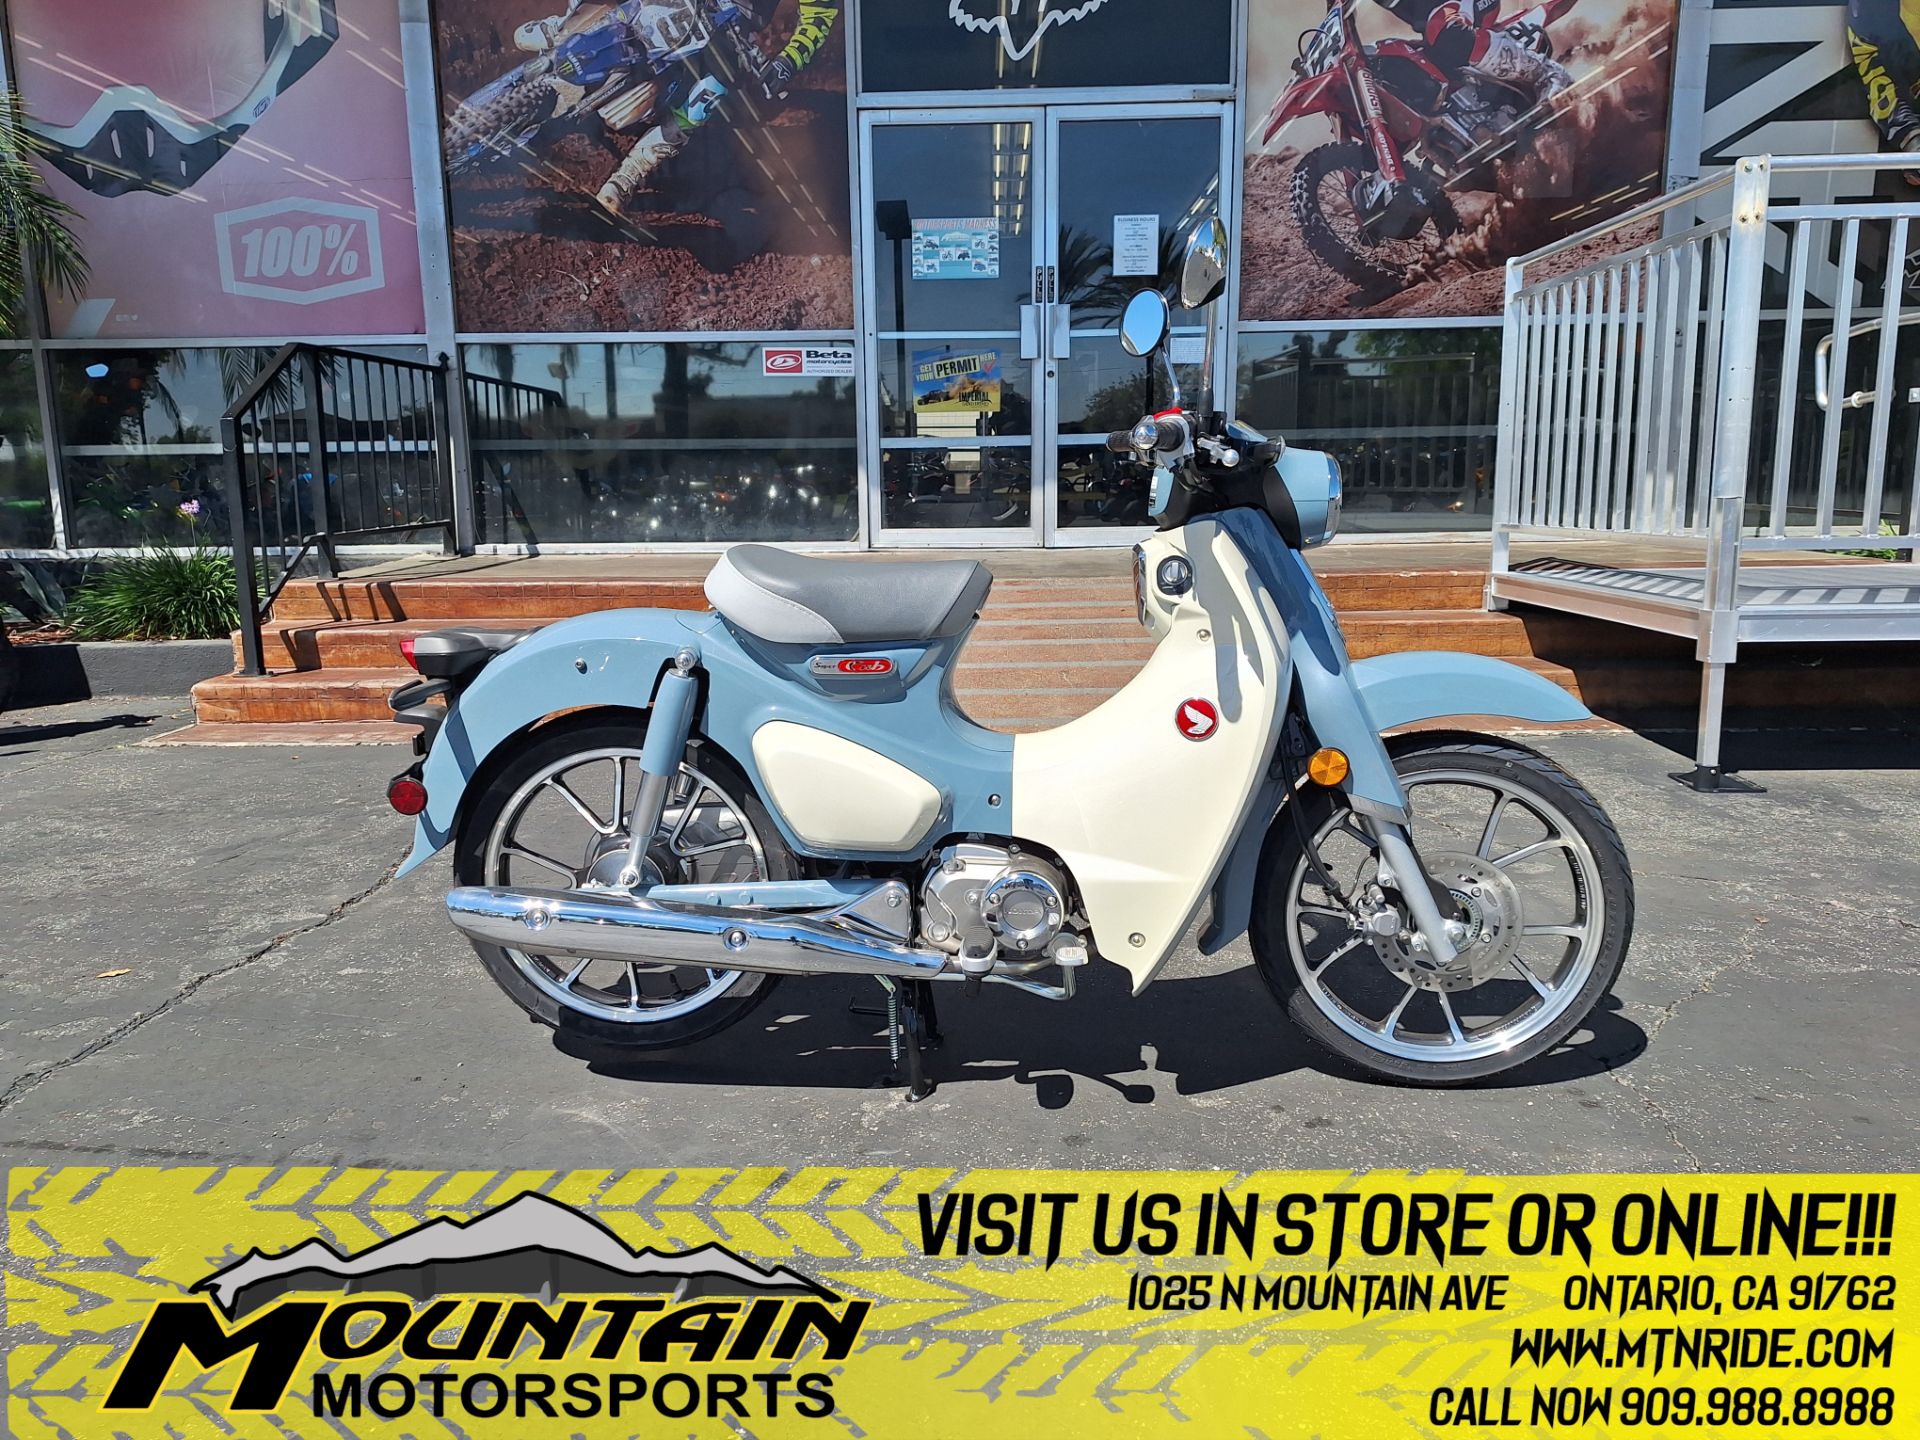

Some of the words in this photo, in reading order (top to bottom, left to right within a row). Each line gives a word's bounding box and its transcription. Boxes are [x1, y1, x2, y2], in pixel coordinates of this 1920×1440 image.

[241, 224, 358, 278] 100%
[806, 350, 852, 358] Beta
[935, 357, 977, 377] PERMIT
[916, 371, 934, 382] YOUR
